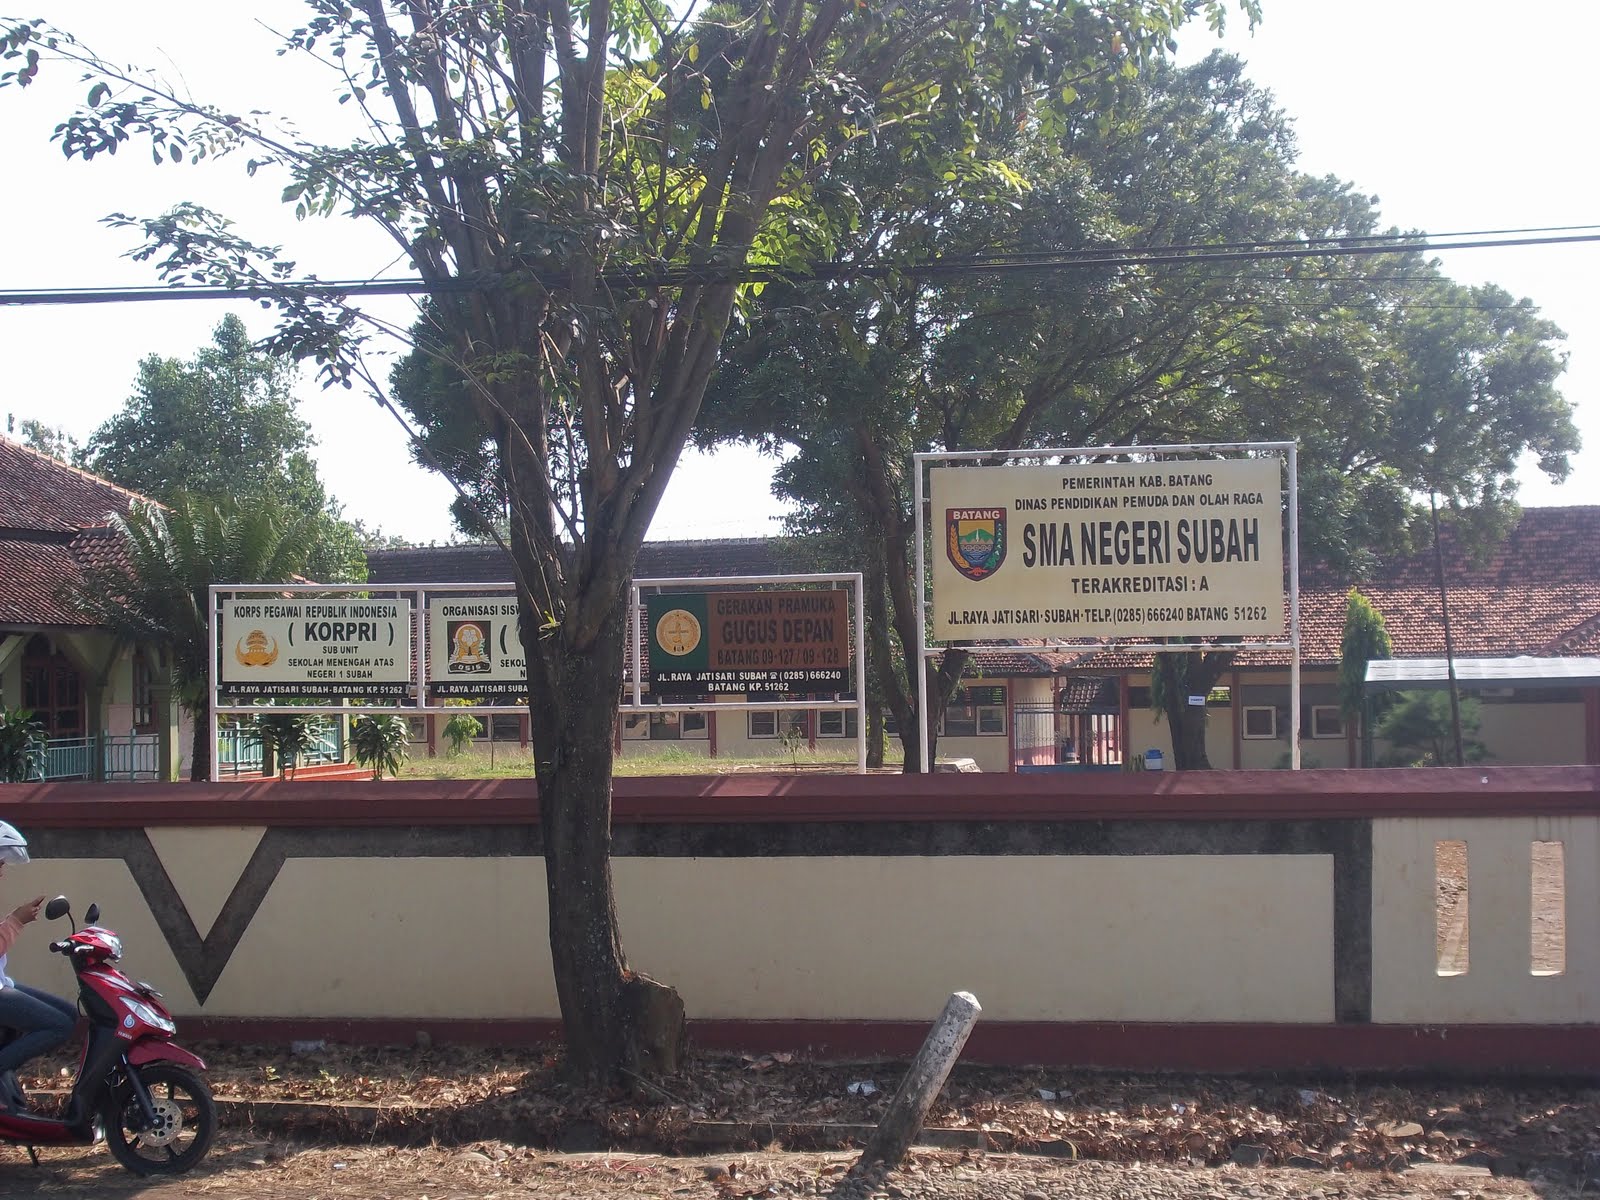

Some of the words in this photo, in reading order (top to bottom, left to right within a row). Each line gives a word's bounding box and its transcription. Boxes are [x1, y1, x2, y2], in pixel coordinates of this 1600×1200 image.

[1062, 476, 1135, 490] PEMERINTAH
[1140, 476, 1166, 488] KAB.
[1169, 474, 1213, 486] BATANG
[1015, 498, 1047, 511] DINAS
[1051, 496, 1118, 510] PENDIDIKAN
[1123, 495, 1169, 508] PEMUDA
[1172, 494, 1195, 506] DAN
[1200, 493, 1229, 506] OLAH
[1233, 492, 1263, 505] RAGA
[953, 510, 1000, 520] BATANG
[1022, 522, 1075, 568] SMA
[1080, 520, 1171, 566] NEGERI
[1177, 518, 1259, 564] SUBAH
[1071, 576, 1188, 594] TERAKREDITASI
[1199, 576, 1209, 591] A
[234, 606, 261, 618] KORPS
[264, 606, 301, 618] PEGAWAI
[305, 606, 347, 618] REPUBLIK
[350, 606, 397, 618] INDONESIA
[442, 605, 498, 616] ORGANISASI
[717, 598, 772, 615] GERAKAN
[778, 597, 835, 613] PRAMUKA
[1186, 607, 1228, 621] BATANG
[1234, 606, 1267, 621] 51262
[305, 622, 377, 641] KORPRI
[722, 620, 777, 643] GUGUS
[782, 618, 833, 642] DEPAN
[322, 646, 338, 654] SUB
[340, 646, 358, 654] UNIT
[288, 658, 324, 667] SEKOLAH
[326, 658, 370, 667] MENENGAH
[374, 658, 394, 667] ATAS
[717, 649, 758, 665] BATANG
[307, 670, 336, 679] NEGERI
[339, 670, 344, 678] 1
[346, 670, 373, 678] SUBAH
[696, 672, 735, 681] JATISARI
[739, 671, 768, 681] SUBAH
[262, 685, 299, 693] JATISARI
[366, 685, 378, 694] KP.
[380, 685, 402, 694] 51262
[470, 685, 506, 693] JATISARI
[708, 682, 745, 692] BATANG
[749, 682, 763, 691] KP.
[764, 682, 789, 691] 51262
